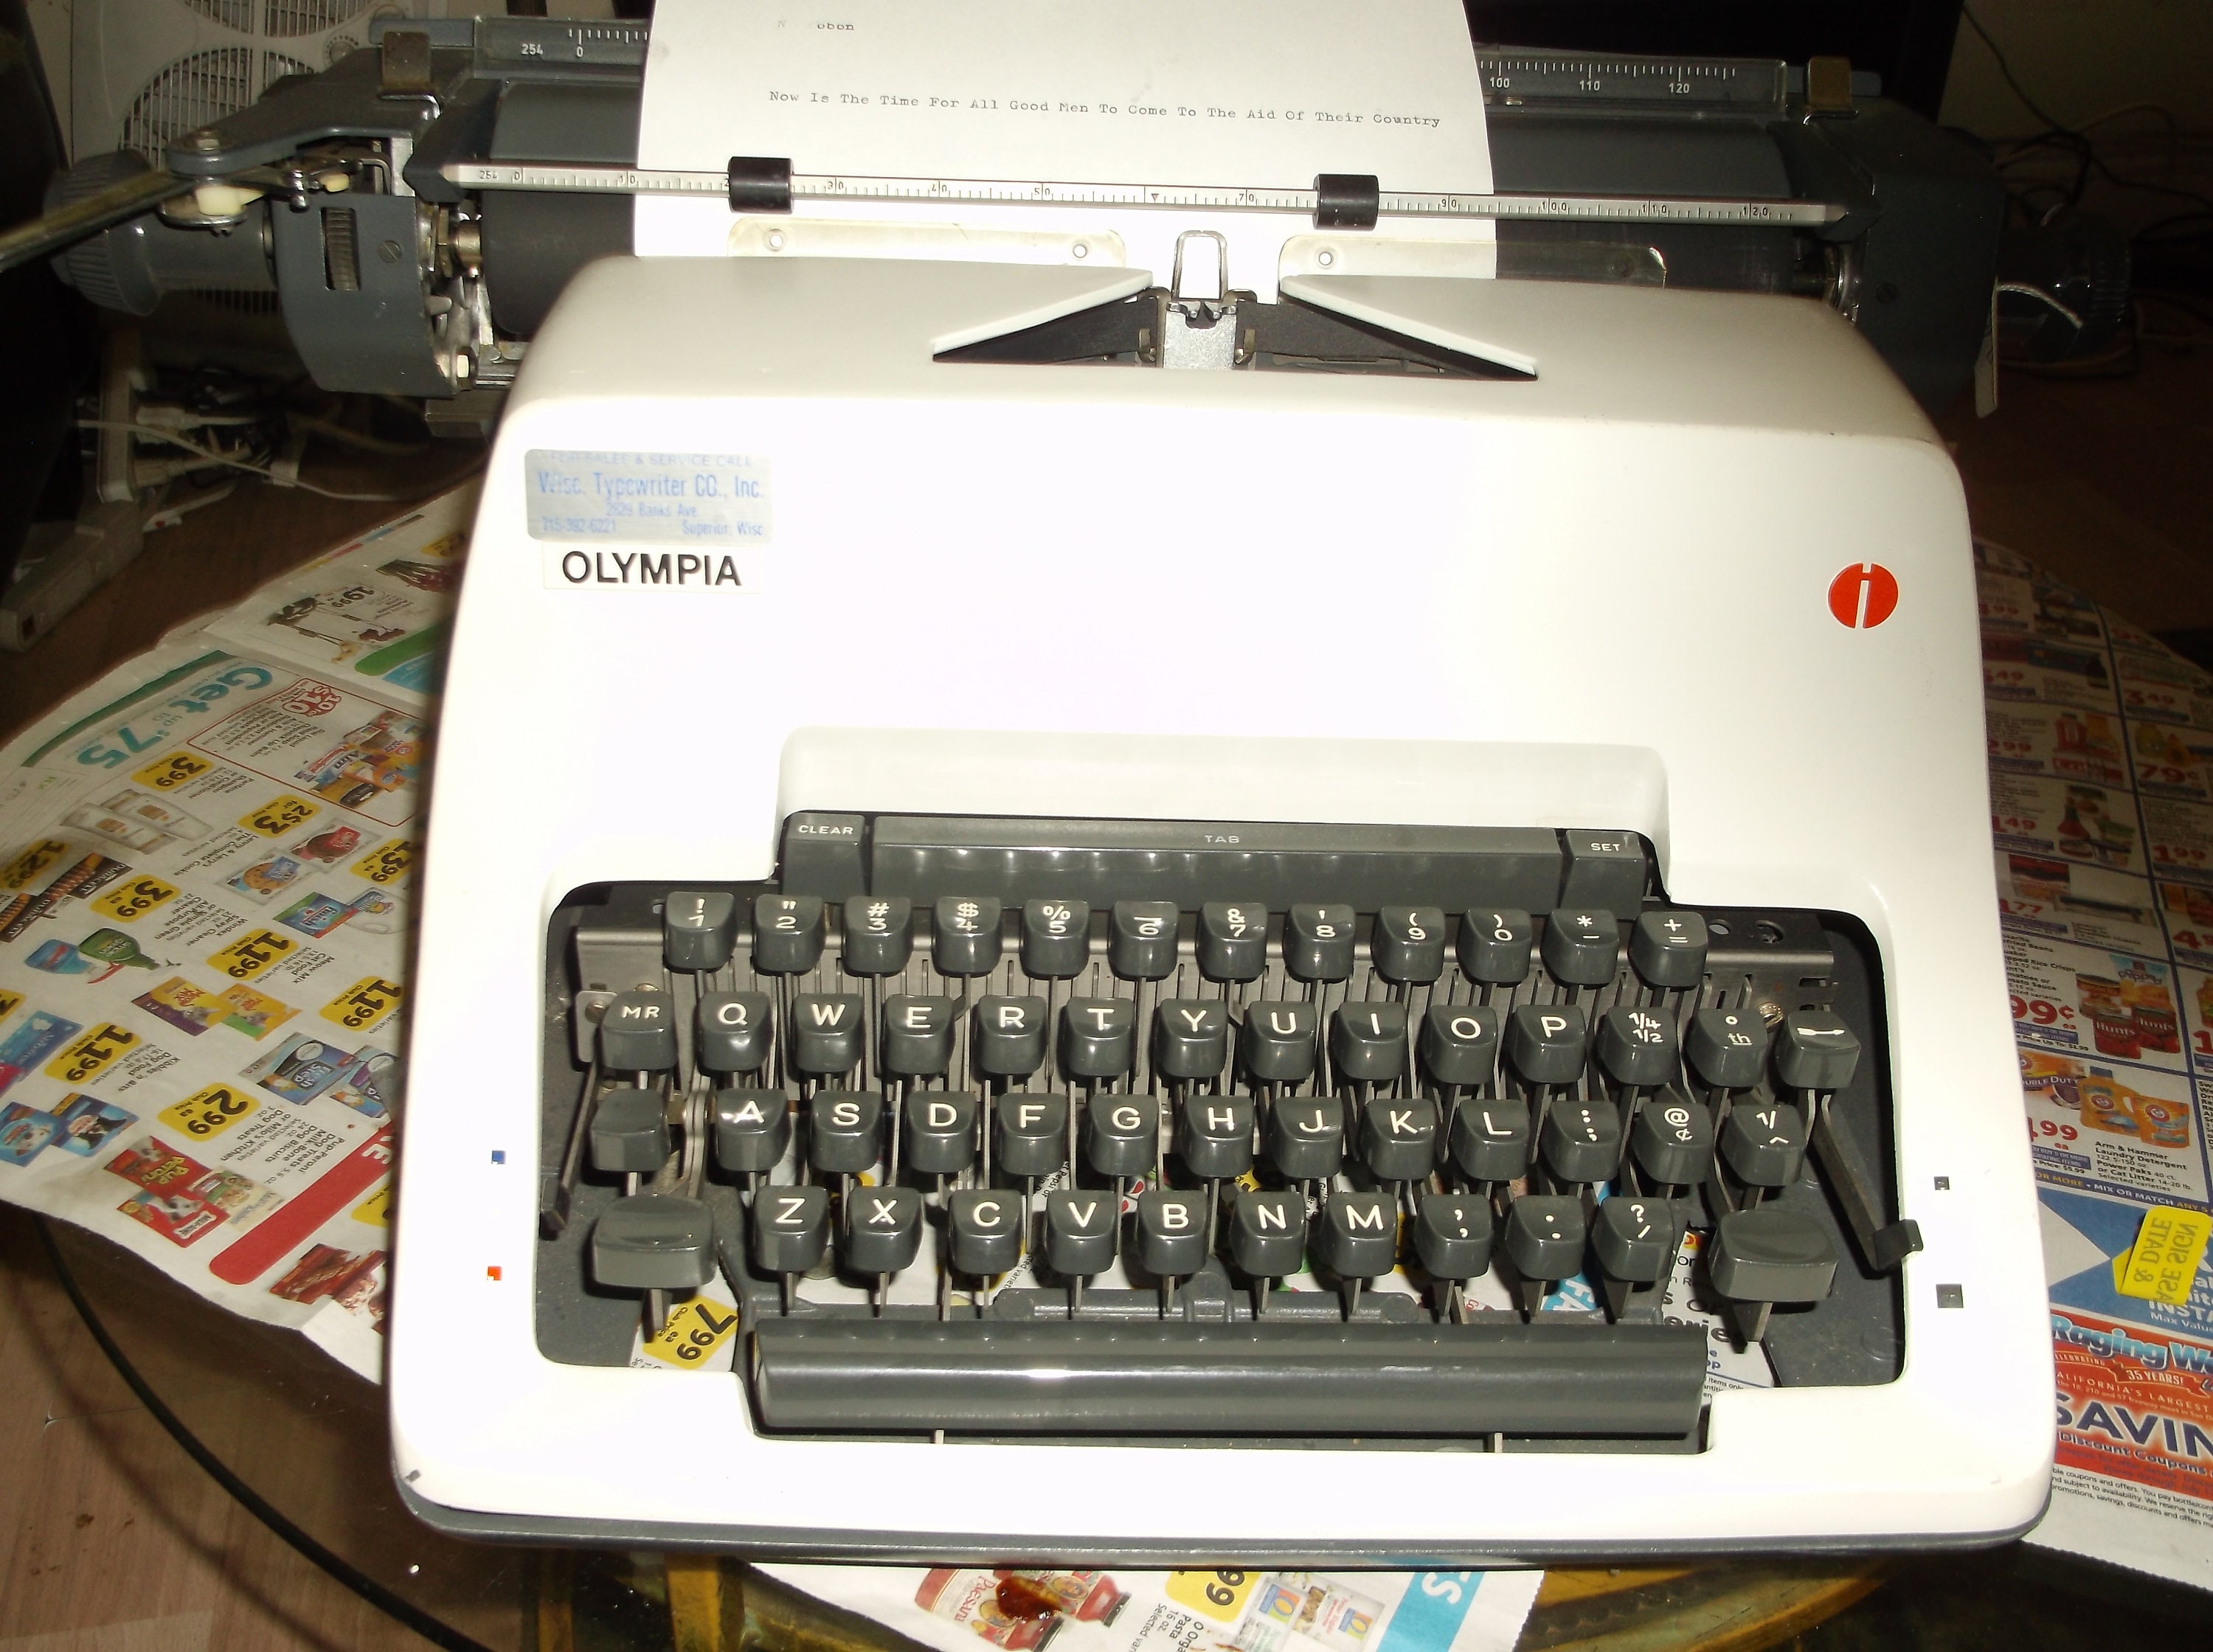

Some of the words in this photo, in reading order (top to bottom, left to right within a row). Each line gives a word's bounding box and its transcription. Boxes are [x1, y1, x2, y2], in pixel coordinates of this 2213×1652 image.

[522, 44, 544, 56] 254
[576, 46, 583, 57] 0
[1489, 77, 1510, 89] 100
[1579, 80, 1600, 91] 110
[1669, 83, 1690, 94] 120
[769, 91, 799, 101] Now
[811, 93, 829, 103] Is
[841, 94, 869, 104] The
[880, 96, 918, 106] Time
[929, 97, 959, 108] For
[969, 100, 998, 109] All
[1010, 100, 1048, 111] Good
[1059, 103, 1088, 112] Men
[1099, 104, 1117, 114] To
[1128, 105, 1167, 115] Come
[1177, 107, 1196, 117] To
[1207, 108, 1236, 118] The
[1247, 111, 1275, 119] Aid
[1286, 111, 1304, 120] Of
[1315, 112, 1363, 122] Their
[1373, 114, 1440, 128] Country
[513, 172, 520, 181] 0
[1239, 193, 1254, 202] 70
[1441, 198, 1457, 208] 90
[636, 454, 643, 464] &
[649, 455, 710, 465] SERVICE
[638, 502, 671, 516] Banks
[562, 551, 742, 586] OLYMPIA
[167, 667, 272, 713] Get
[799, 825, 853, 835] CLEAR
[1205, 836, 1240, 844] TAB
[1590, 842, 1621, 852] SET
[180, 904, 208, 926] Simple
[957, 902, 979, 917] $
[1043, 906, 1071, 920] %
[1227, 909, 1245, 923] &
[214, 913, 240, 929] Spray
[215, 917, 249, 937] Windex
[776, 916, 796, 929] 2
[868, 918, 887, 931] 3
[1049, 920, 1067, 934] 5
[1139, 923, 1159, 936] 6
[1230, 924, 1246, 937] 7
[1316, 924, 1337, 937] 8
[153, 926, 180, 940] Green
[186, 929, 216, 946] Cleaner
[1408, 927, 1427, 940] 9
[308, 956, 335, 972] Meow
[310, 953, 326, 962] Cat
[291, 961, 313, 976] Food
[292, 972, 308, 984] Mix
[622, 1006, 659, 1018] MR
[718, 1003, 747, 1026] Q
[811, 1004, 845, 1026] W
[906, 1007, 932, 1028] E
[1000, 1007, 1025, 1028] R
[1087, 1008, 1114, 1030] T
[1181, 1010, 1206, 1032] Y
[1271, 1012, 1295, 1034] U
[1371, 1013, 1380, 1035] I
[1451, 1017, 1481, 1038] O
[1540, 1016, 1567, 1038] P
[1728, 1032, 1752, 1046] th
[147, 1054, 181, 1075] Kibbles
[733, 1100, 765, 1123] A
[833, 1103, 861, 1126] S
[929, 1103, 957, 1127] D
[1020, 1105, 1046, 1128] F
[1112, 1106, 1140, 1130] G
[1208, 1107, 1234, 1131] H
[1299, 1109, 1323, 1133] J
[1664, 1108, 1689, 1127] @
[254, 1122, 282, 1139] Milo's
[296, 1123, 318, 1139] Dog
[1390, 1110, 1419, 1134] K
[1483, 1111, 1512, 1135] L
[220, 1135, 256, 1162] Kitchen
[265, 1134, 299, 1163] Biscuits
[283, 1127, 327, 1166] Milk-Bone
[314, 1133, 336, 1148] Dog
[289, 1148, 319, 1167] Treats
[298, 1135, 346, 1173] Pup-Peroni
[2094, 1141, 2115, 1150] Arm
[2127, 1147, 2168, 1160] Hammer
[2095, 1147, 2135, 1162] Laundry
[2137, 1155, 2187, 1170] Detergent
[2096, 1159, 2127, 1170] Power
[2129, 1166, 2152, 1176] Paks
[2110, 1169, 2126, 1177] Cat
[2129, 1173, 2155, 1183] Litter
[2093, 1184, 2113, 1193] MIX
[2116, 1189, 2133, 1197] OR
[2135, 1193, 2174, 1206] MATCH
[775, 1198, 805, 1224] Z
[868, 1198, 898, 1224] X
[973, 1201, 1001, 1227] C
[1069, 1201, 1097, 1228] V
[1163, 1203, 1189, 1229] B
[1258, 1204, 1286, 1229] N
[1346, 1204, 1384, 1230] M
[2051, 1316, 2167, 1370] Raging
[2125, 1370, 2143, 1381] 35
[2145, 1371, 2183, 1384] YEARS!
[2150, 1392, 2209, 1412] LARGEST
[2058, 1431, 2130, 1457] Discount
[2134, 1450, 2208, 1475] Coupons
